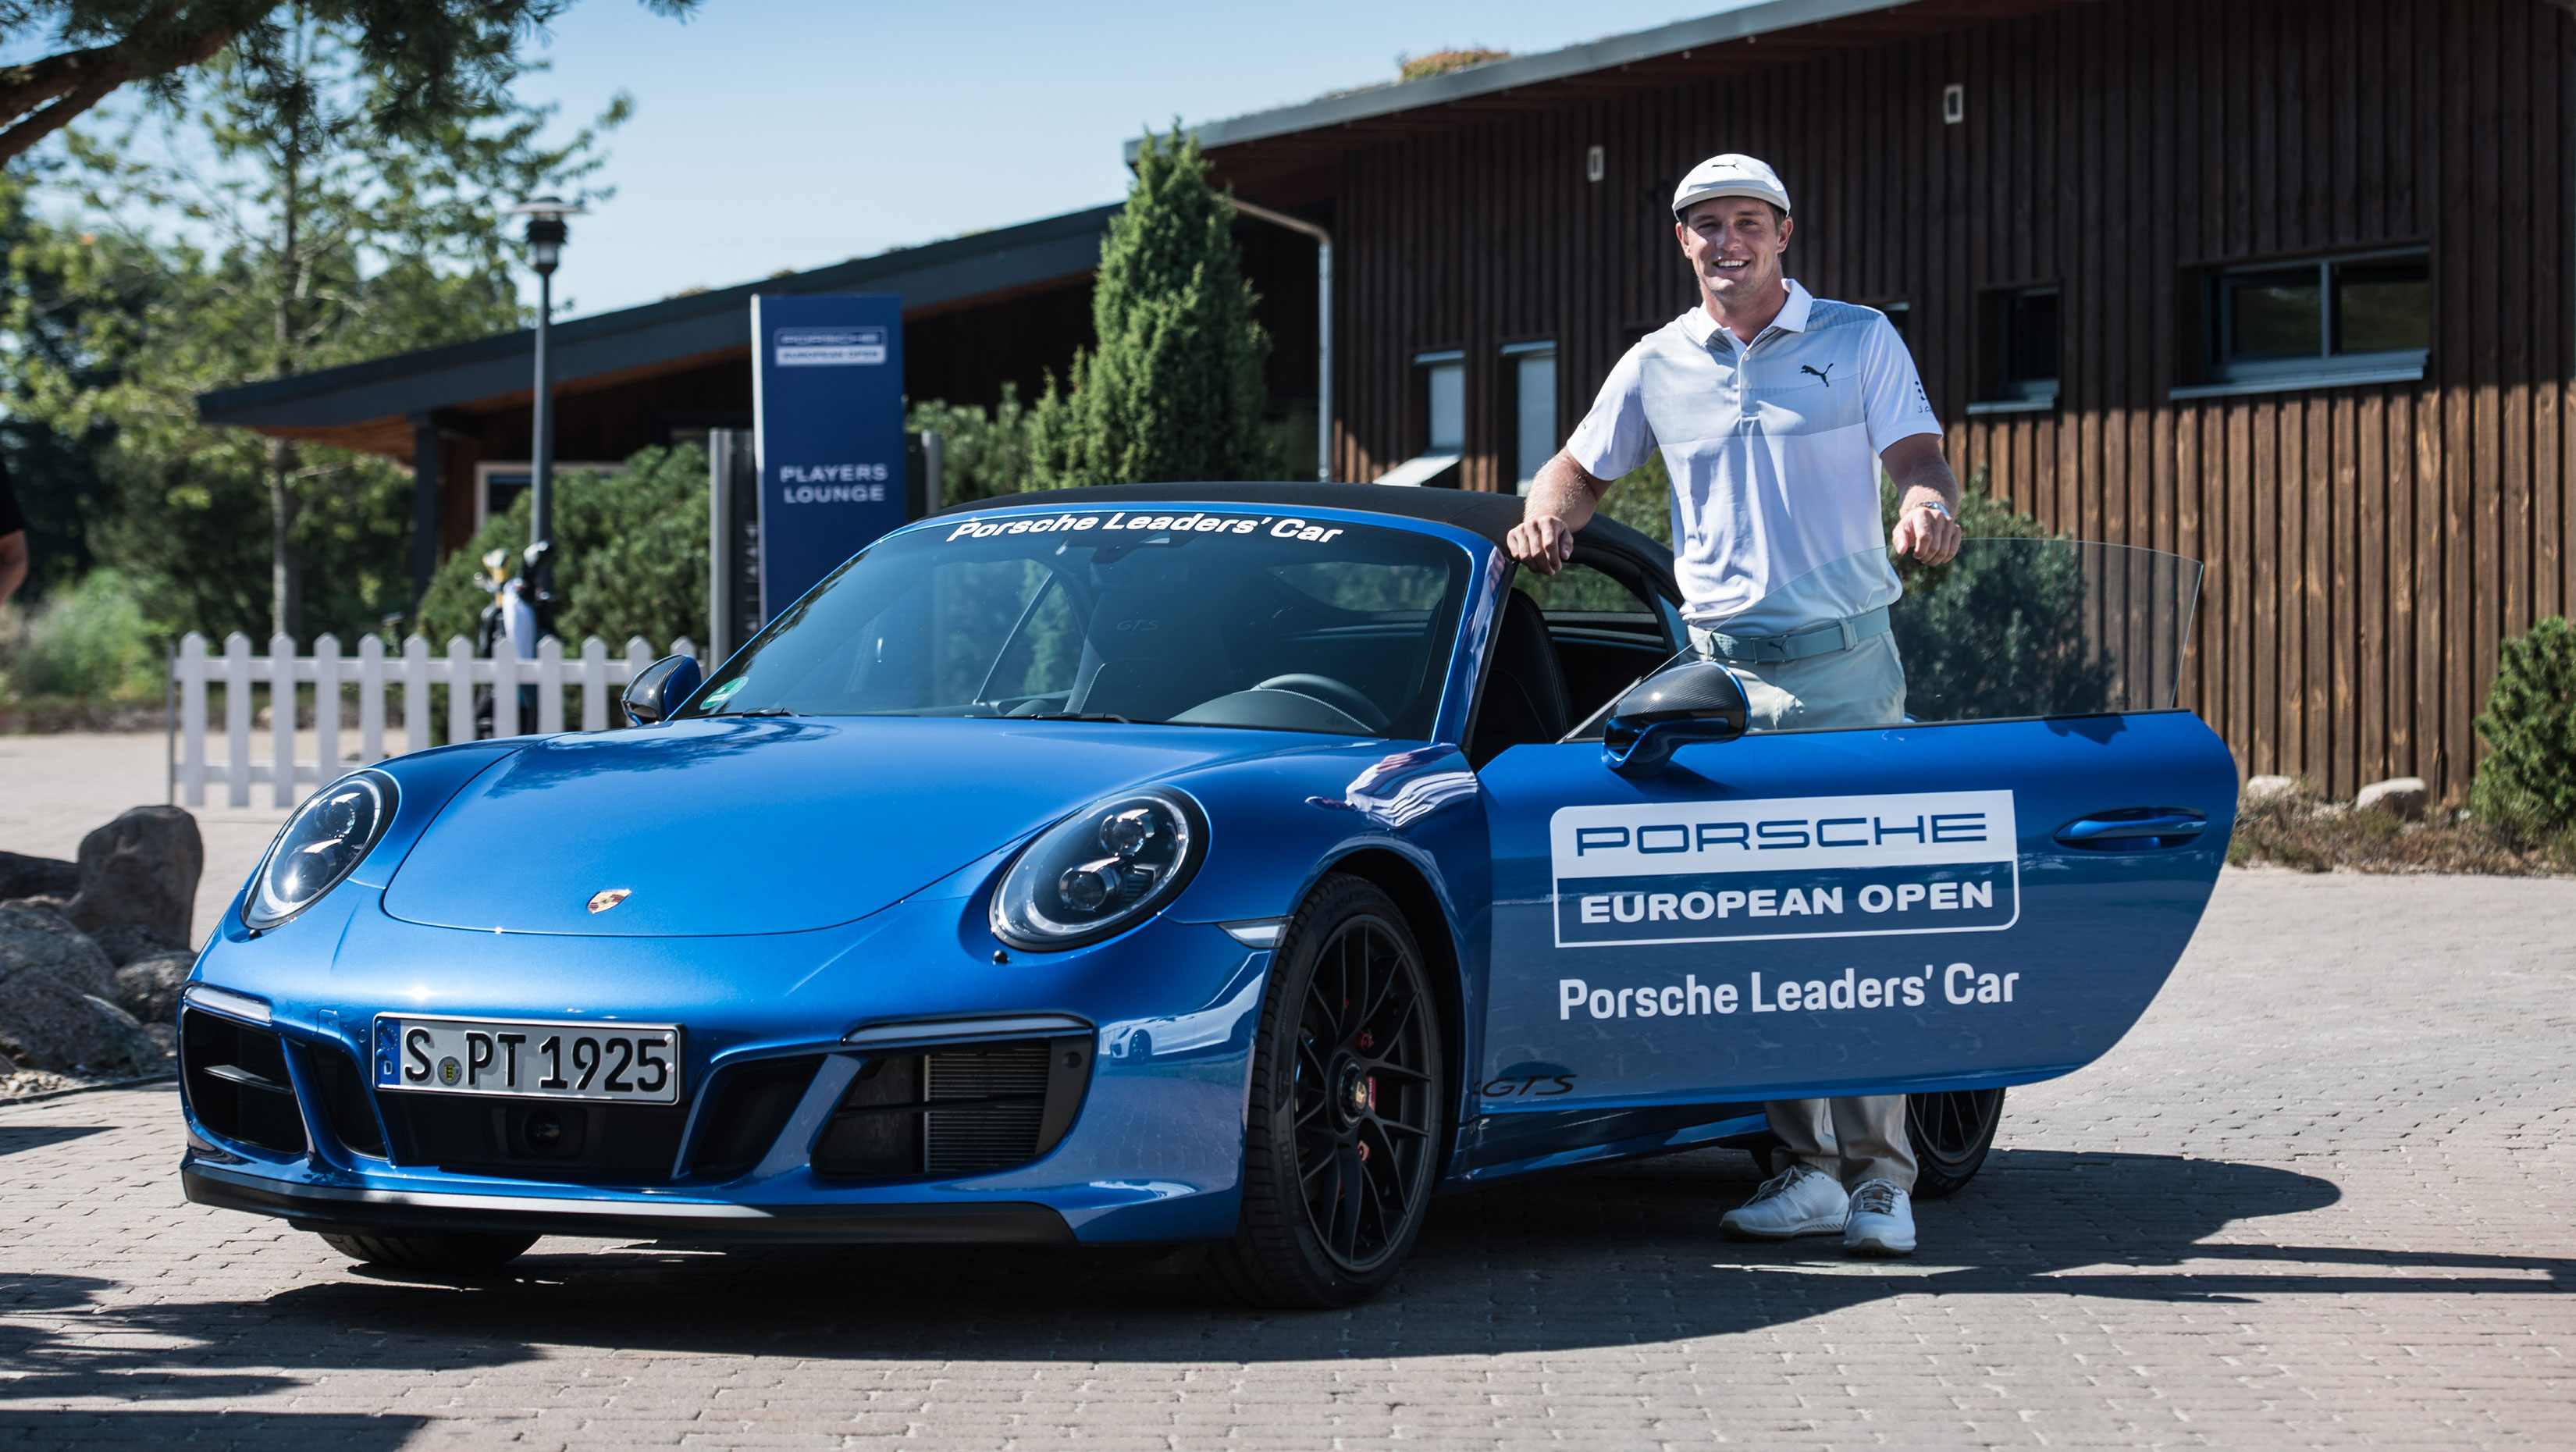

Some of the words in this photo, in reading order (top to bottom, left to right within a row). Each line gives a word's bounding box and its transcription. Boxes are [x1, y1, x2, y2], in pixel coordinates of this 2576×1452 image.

[781, 464, 888, 482] PLAYERS
[784, 485, 884, 504] LOUNGE
[945, 514, 1099, 543] Porsche
[1270, 518, 1344, 543] Car
[1576, 813, 1987, 857] PORSCHE
[1581, 887, 1844, 924] EUROPEAN
[1858, 881, 1993, 914] OPEN
[1559, 974, 1738, 1020] Porsche
[1944, 963, 2019, 1005] Car
[404, 1028, 432, 1082] S
[540, 1035, 667, 1093] 1925
[1482, 1074, 1578, 1098] GTS
